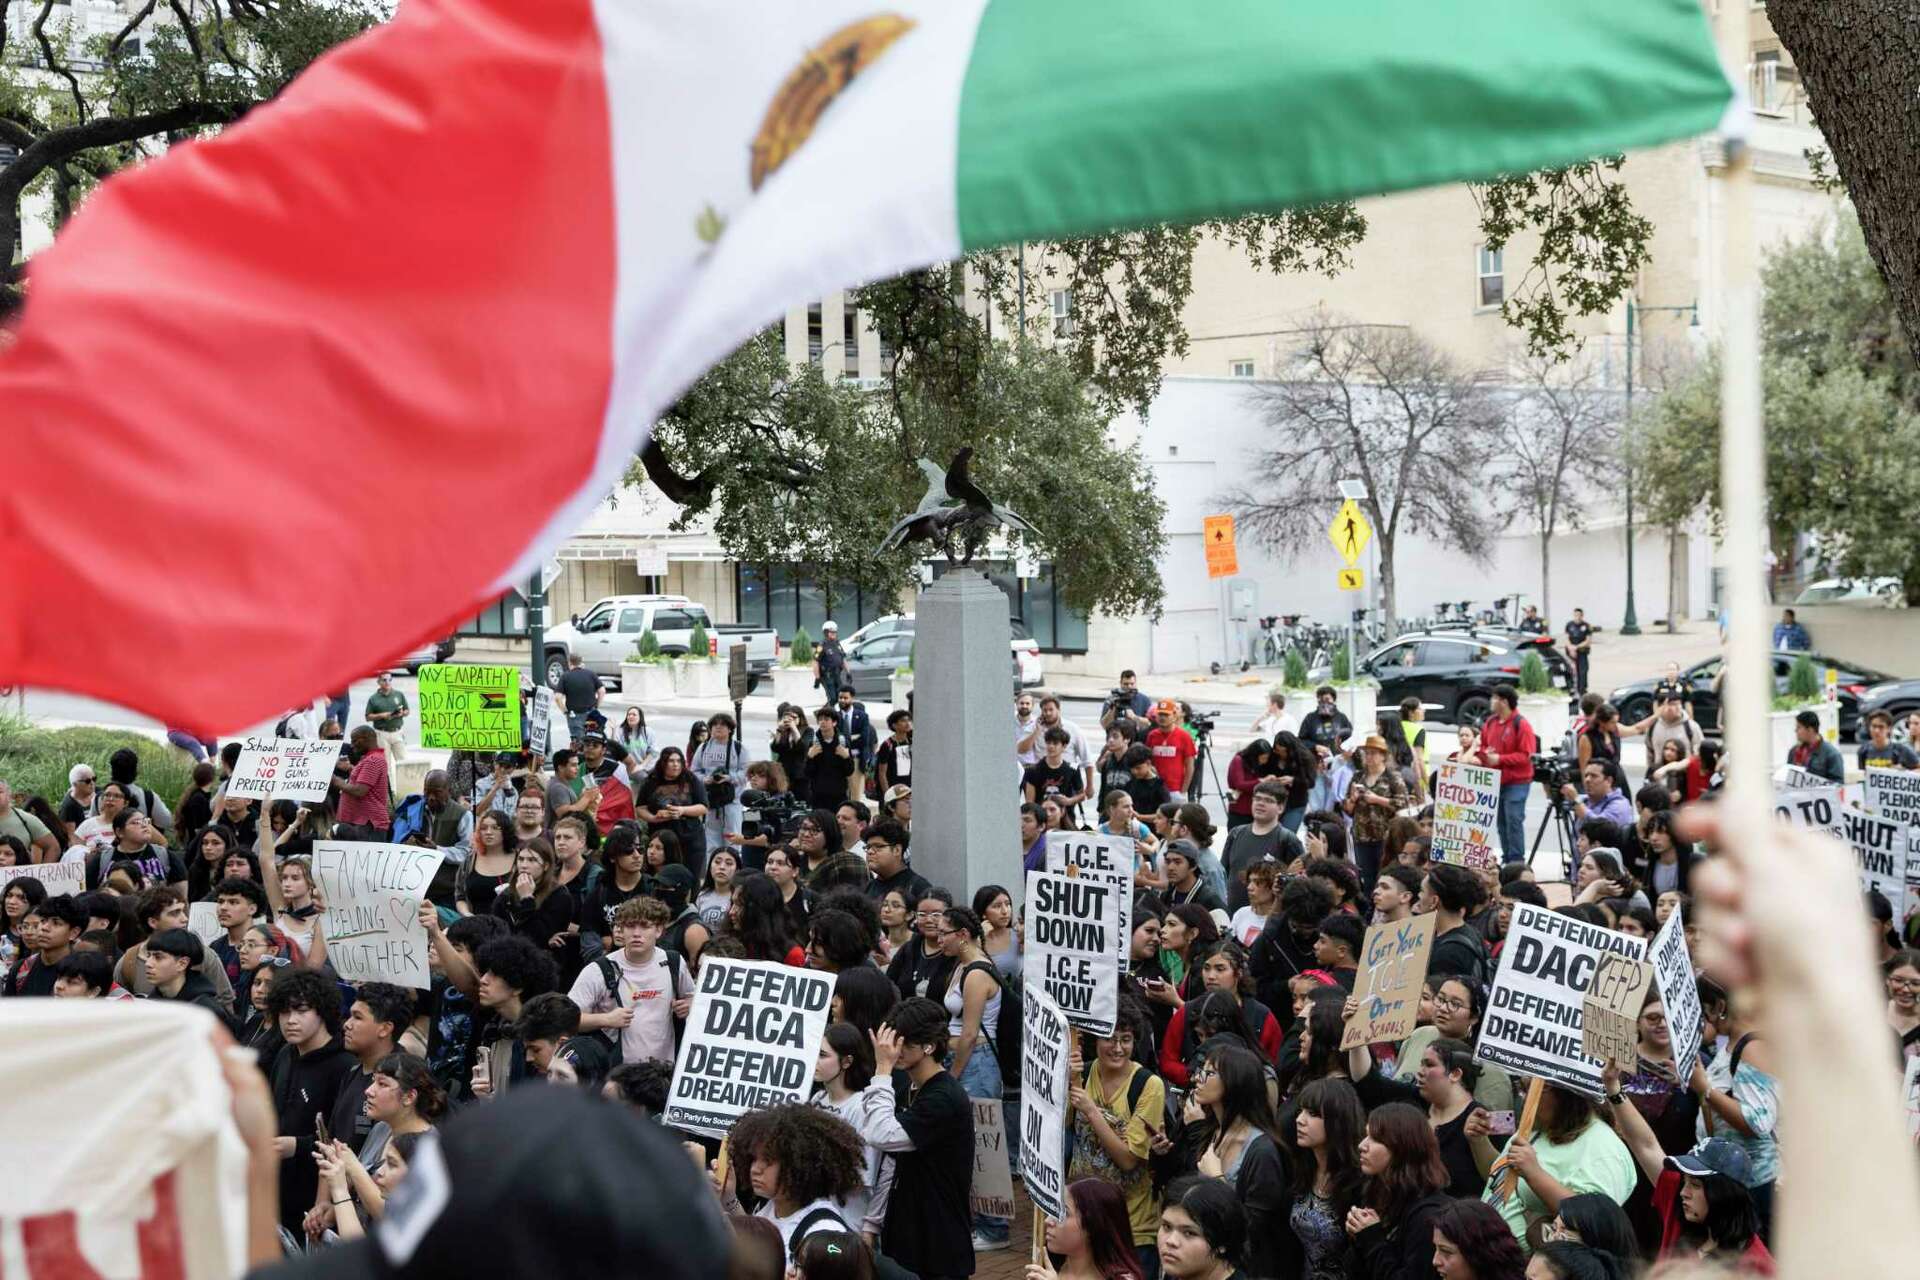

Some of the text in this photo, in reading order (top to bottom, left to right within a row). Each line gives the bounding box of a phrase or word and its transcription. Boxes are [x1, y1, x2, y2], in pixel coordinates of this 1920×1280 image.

[420, 667, 512, 686] MY EMPATHY
[420, 691, 474, 710] DID NOT
[421, 711, 512, 730] RADICALIZE
[260, 757, 309, 767] NO ICE
[285, 742, 305, 753] need
[235, 778, 276, 792] PROTECT
[256, 768, 310, 779] NO GUNS
[1440, 765, 1493, 786] IF THE
[1438, 782, 1497, 809] FETUS YOU
[1465, 809, 1478, 823] IS
[1797, 798, 1832, 826] TO
[1435, 822, 1466, 841] WILL
[1065, 843, 1115, 871] I.C.E.
[319, 849, 436, 900] FAMILIES
[1035, 878, 1108, 921] SHUT
[328, 905, 386, 938] BELONG
[1036, 915, 1105, 953] DOWN
[1518, 908, 1642, 960] DEFIENDAN
[1046, 954, 1096, 986] I.C.E.
[1512, 935, 1597, 993] DAC
[701, 963, 830, 1012] DEFEND
[1044, 980, 1093, 1011] NOW
[1588, 951, 1641, 1011] KEEP
[1492, 985, 1583, 1031] DEFIEND
[703, 999, 804, 1049] DACA
[1040, 1005, 1062, 1045] THE
[684, 1043, 807, 1090] DEFEND
[1033, 1034, 1059, 1072] PARTY
[1495, 1051, 1514, 1064] Party
[1513, 1056, 1524, 1066] for
[683, 1112, 701, 1123] Party
[702, 1115, 713, 1123] for
[1026, 1103, 1042, 1153] ON
